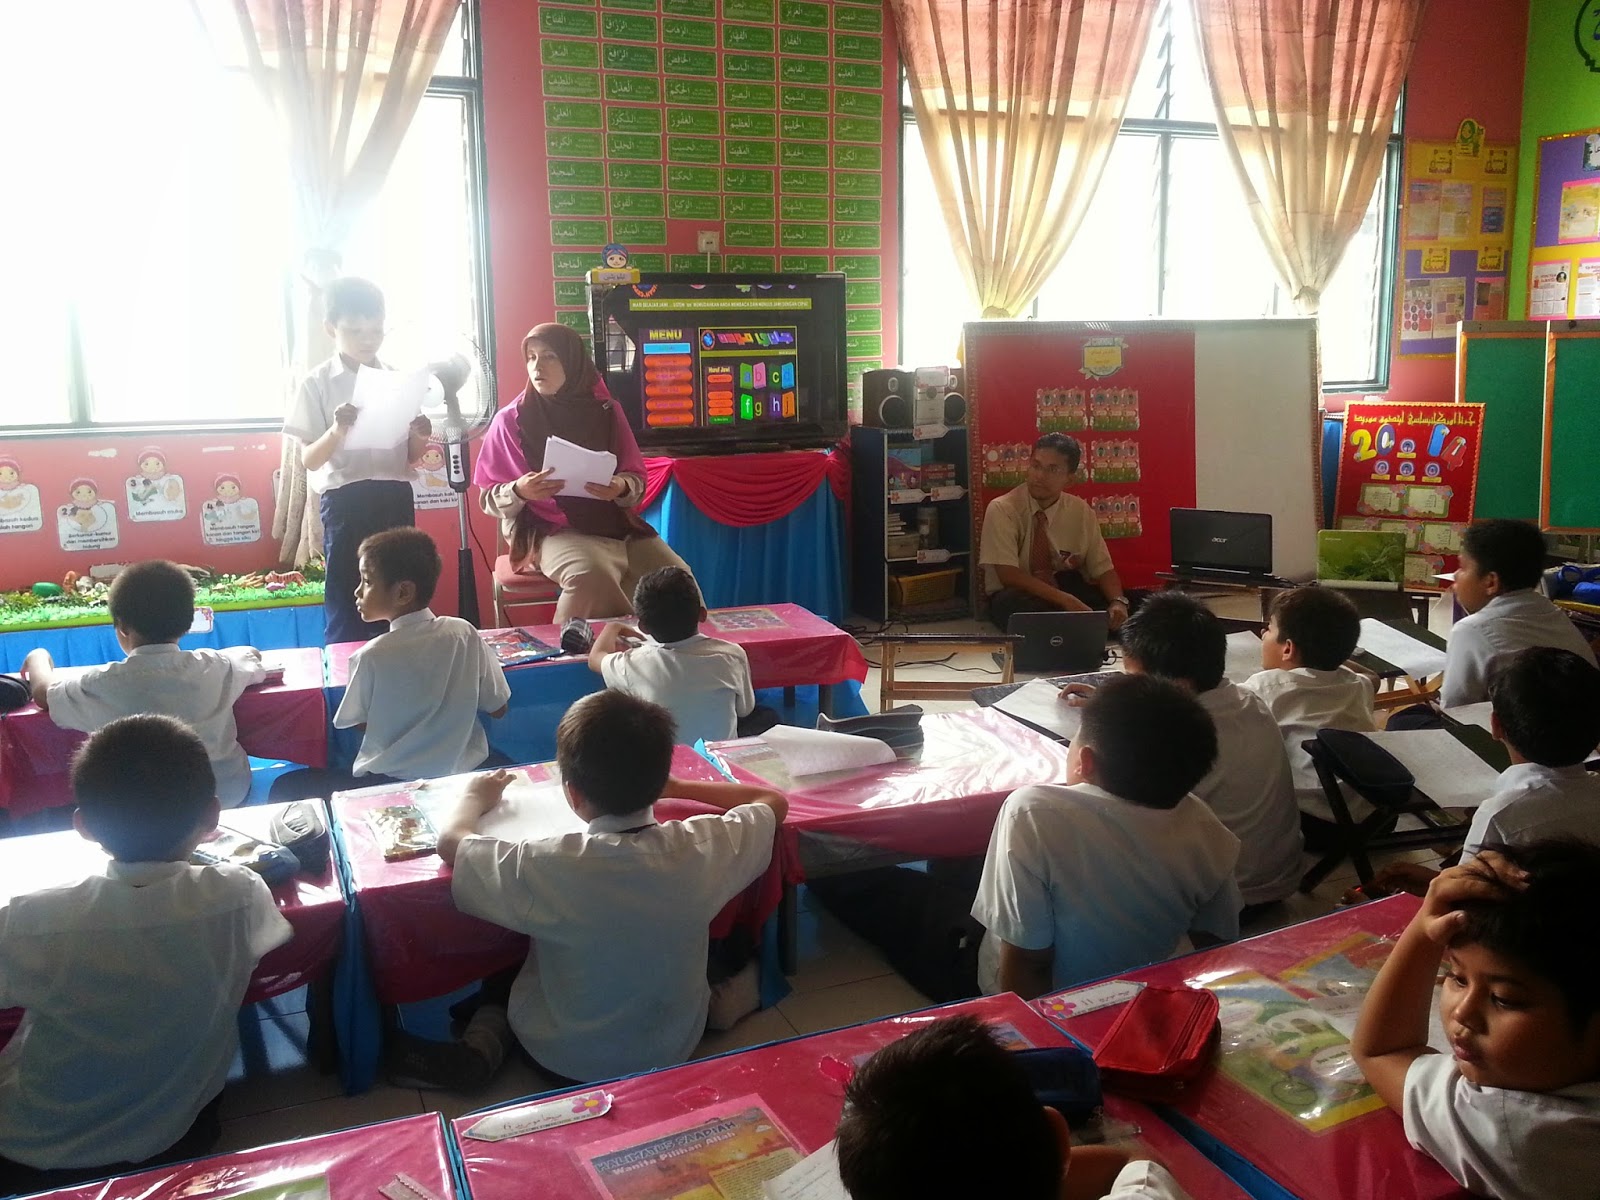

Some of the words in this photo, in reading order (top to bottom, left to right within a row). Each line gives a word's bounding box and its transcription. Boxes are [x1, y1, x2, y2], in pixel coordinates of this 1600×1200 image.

[650, 329, 682, 340] MENU
[130, 479, 136, 487] 3
[675, 1121, 736, 1146] SAADIAH
[612, 1158, 657, 1175] Wanita
[659, 1144, 702, 1161] Pilihan
[705, 1132, 736, 1146] Allah
